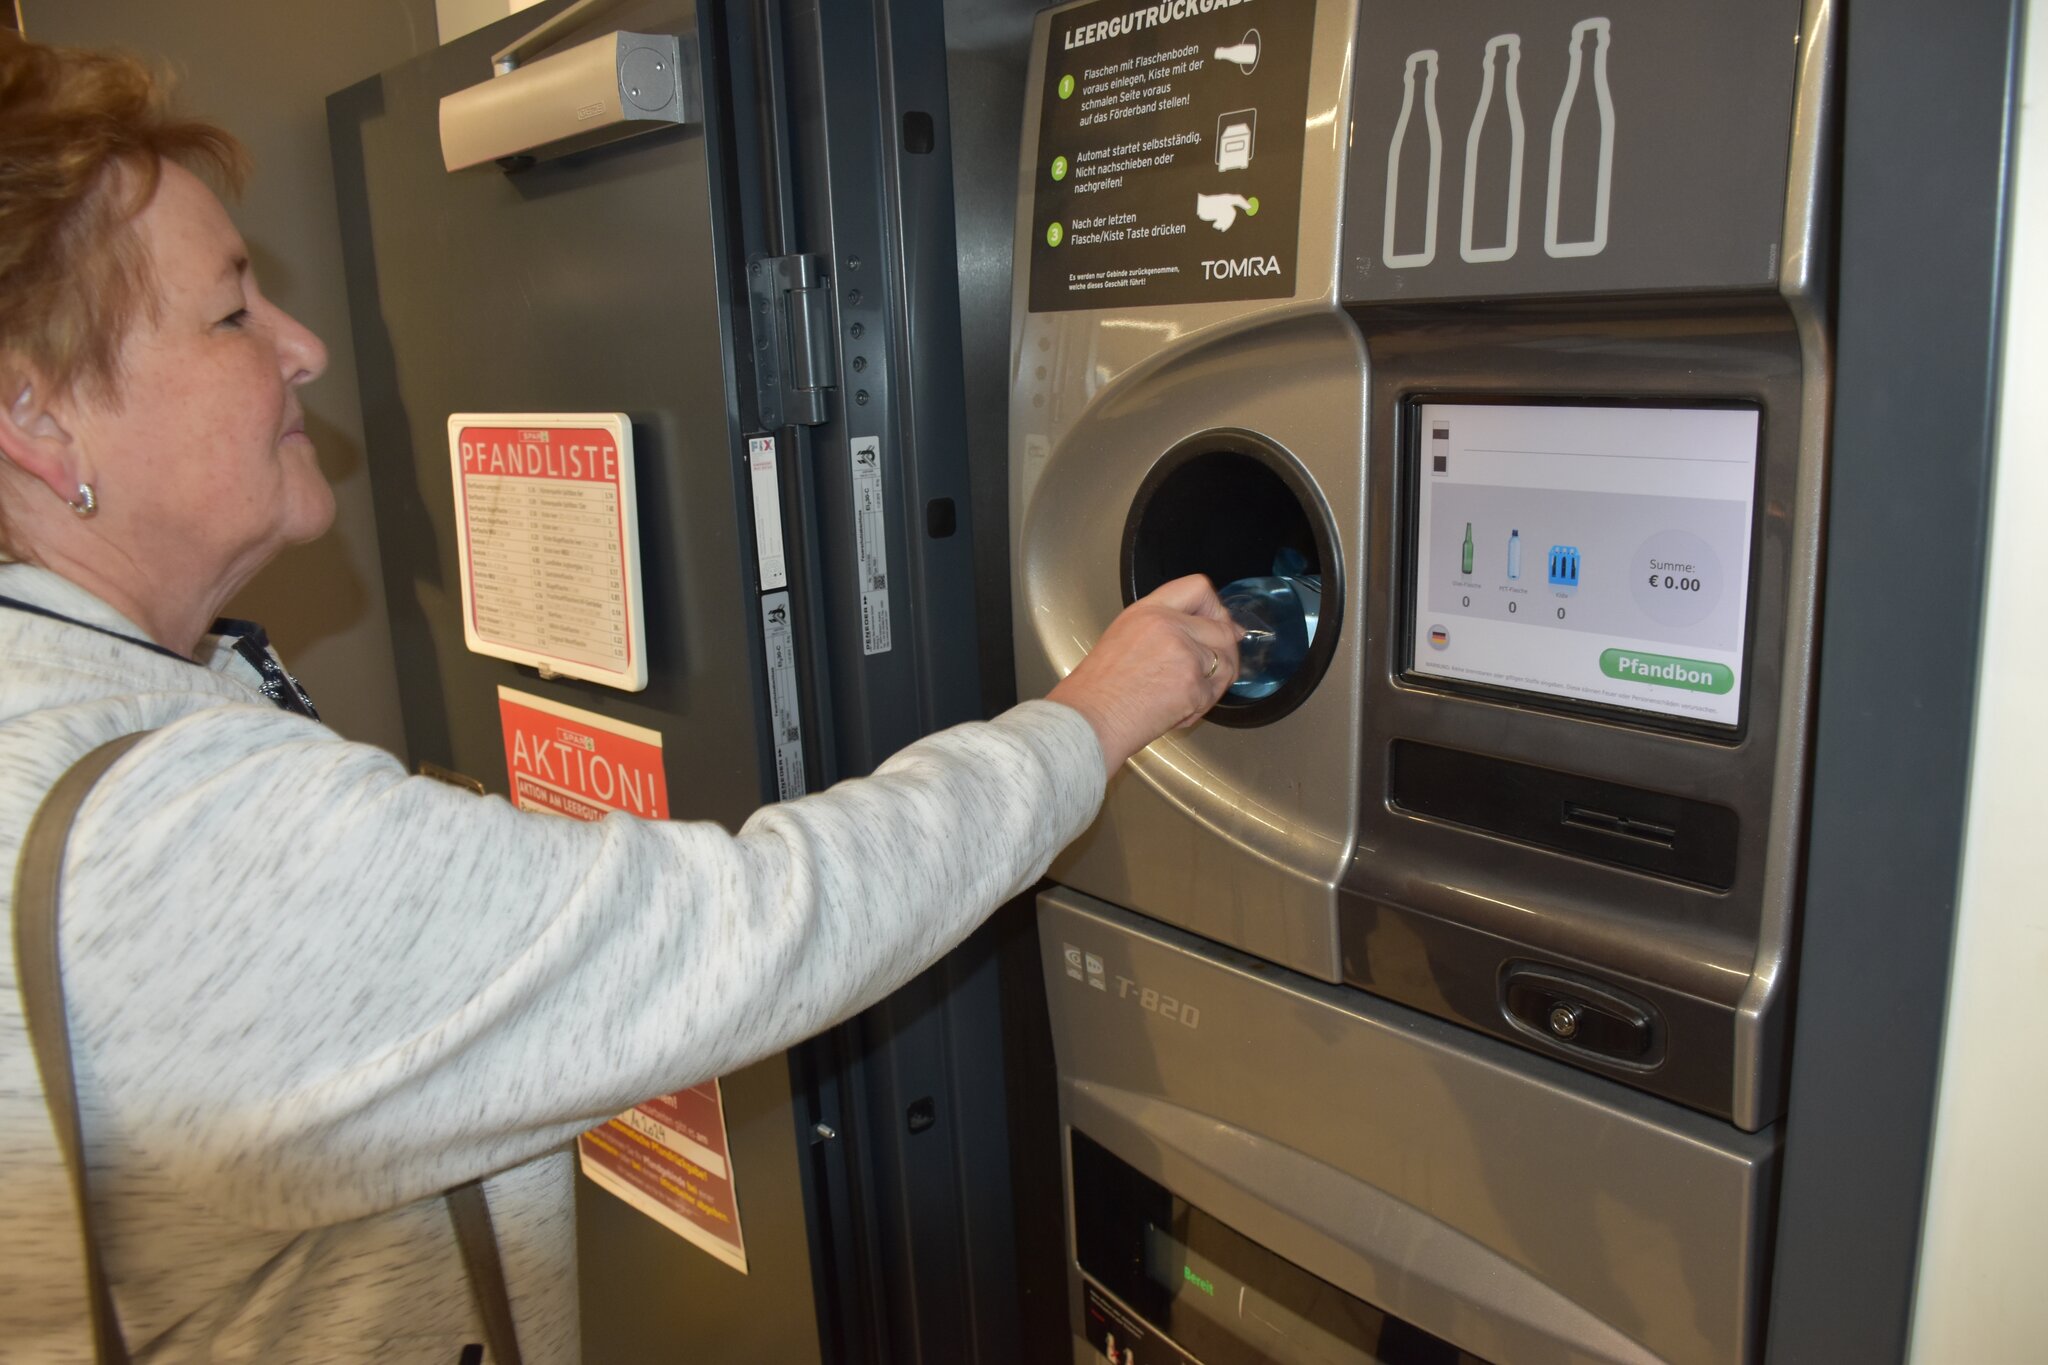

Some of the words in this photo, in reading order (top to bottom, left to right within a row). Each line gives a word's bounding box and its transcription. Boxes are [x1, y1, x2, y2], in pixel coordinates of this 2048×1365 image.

[1064, 0, 1253, 50] LEERGUTRÜCKGA
[1084, 65, 1118, 80] Flaschen
[1120, 60, 1133, 72] mit
[1136, 45, 1199, 68] Flaschenboden
[1083, 83, 1108, 95] voraus
[1110, 74, 1146, 90] einlegen,
[1148, 67, 1170, 80] Kiste
[1172, 62, 1187, 75] mit
[1188, 59, 1204, 71] der
[1081, 96, 1117, 111] schmalen
[1120, 88, 1141, 102] Seite
[1143, 83, 1171, 98] voraus
[1079, 113, 1092, 127] auf
[1093, 110, 1108, 123] das
[1109, 101, 1157, 121] Förderband
[1158, 94, 1190, 111] stellen!
[1077, 148, 1110, 163] Automat
[1112, 143, 1140, 157] startet
[1142, 132, 1202, 152] selbstständig.
[1075, 165, 1096, 178] Nicht
[1097, 156, 1152, 175] nachschieben
[1154, 152, 1175, 166] oder
[1074, 176, 1123, 194] nachgreifen!
[1071, 227, 1124, 246] Flasche/Kiste
[1126, 226, 1149, 240] Taste
[1151, 223, 1186, 237] drücken
[1072, 217, 1092, 230] Nach
[1093, 215, 1106, 228] der
[1108, 213, 1137, 225] letzten
[1069, 273, 1076, 281] Es
[1076, 272, 1095, 280] werden
[1096, 271, 1106, 279] nur
[1106, 269, 1128, 279] Gebinde
[1201, 255, 1281, 281] TOMRA
[1068, 282, 1086, 291] welche
[1086, 280, 1104, 289] dieses
[1104, 278, 1129, 288] Geschäft
[1129, 277, 1146, 287] führt!
[462, 442, 616, 479] PFANDLISTE
[1650, 559, 1696, 573] Summe:
[1648, 574, 1659, 588] €
[1664, 576, 1701, 592] 0.00
[1462, 596, 1470, 608] 0
[1508, 601, 1517, 613] 0
[1557, 607, 1566, 620] 0
[1618, 657, 1713, 686] Pfandbon
[513, 729, 658, 818] AKTION!
[1115, 975, 1200, 1029] T-820
[1183, 1265, 1214, 1297] Bereit
